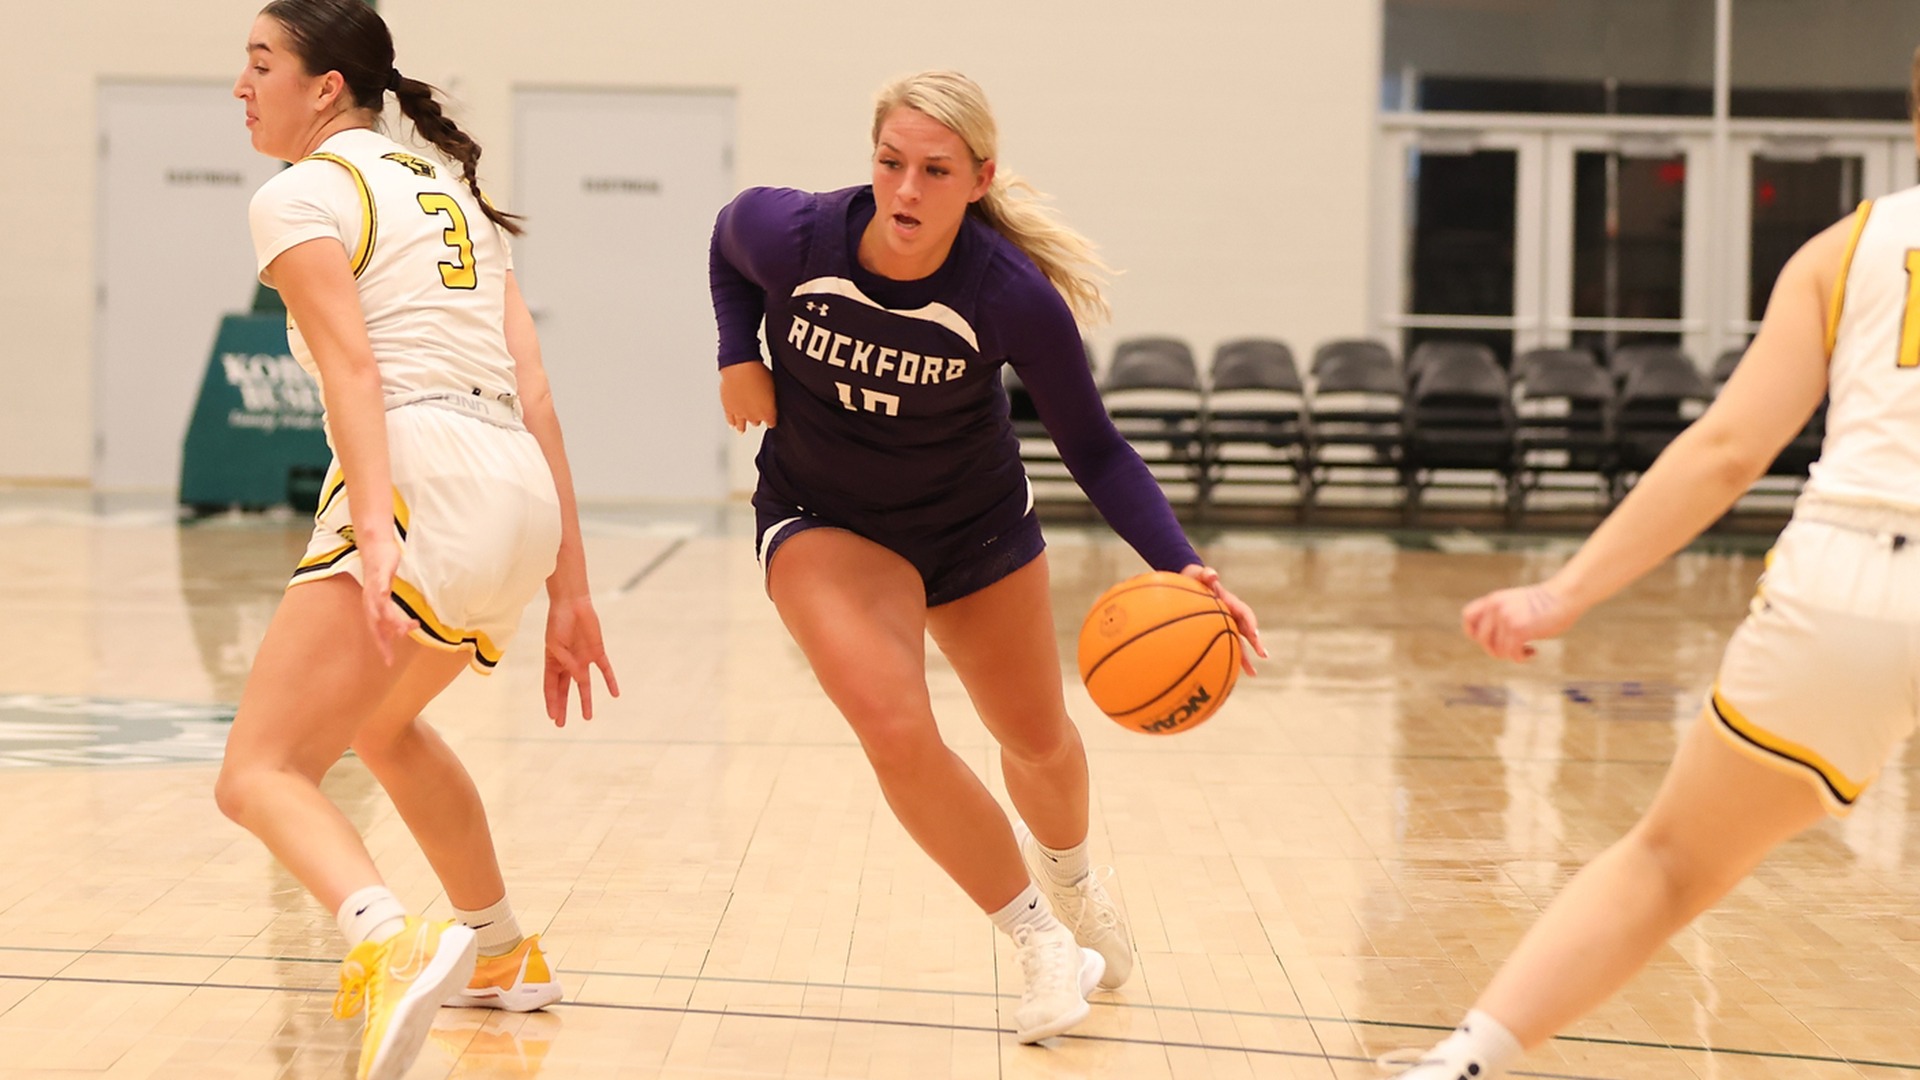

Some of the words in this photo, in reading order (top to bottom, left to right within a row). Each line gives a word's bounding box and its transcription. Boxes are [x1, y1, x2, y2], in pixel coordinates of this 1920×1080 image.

[416, 191, 478, 290] 3
[788, 315, 967, 385] ROCKFORD
[1141, 686, 1212, 733] NCAA
